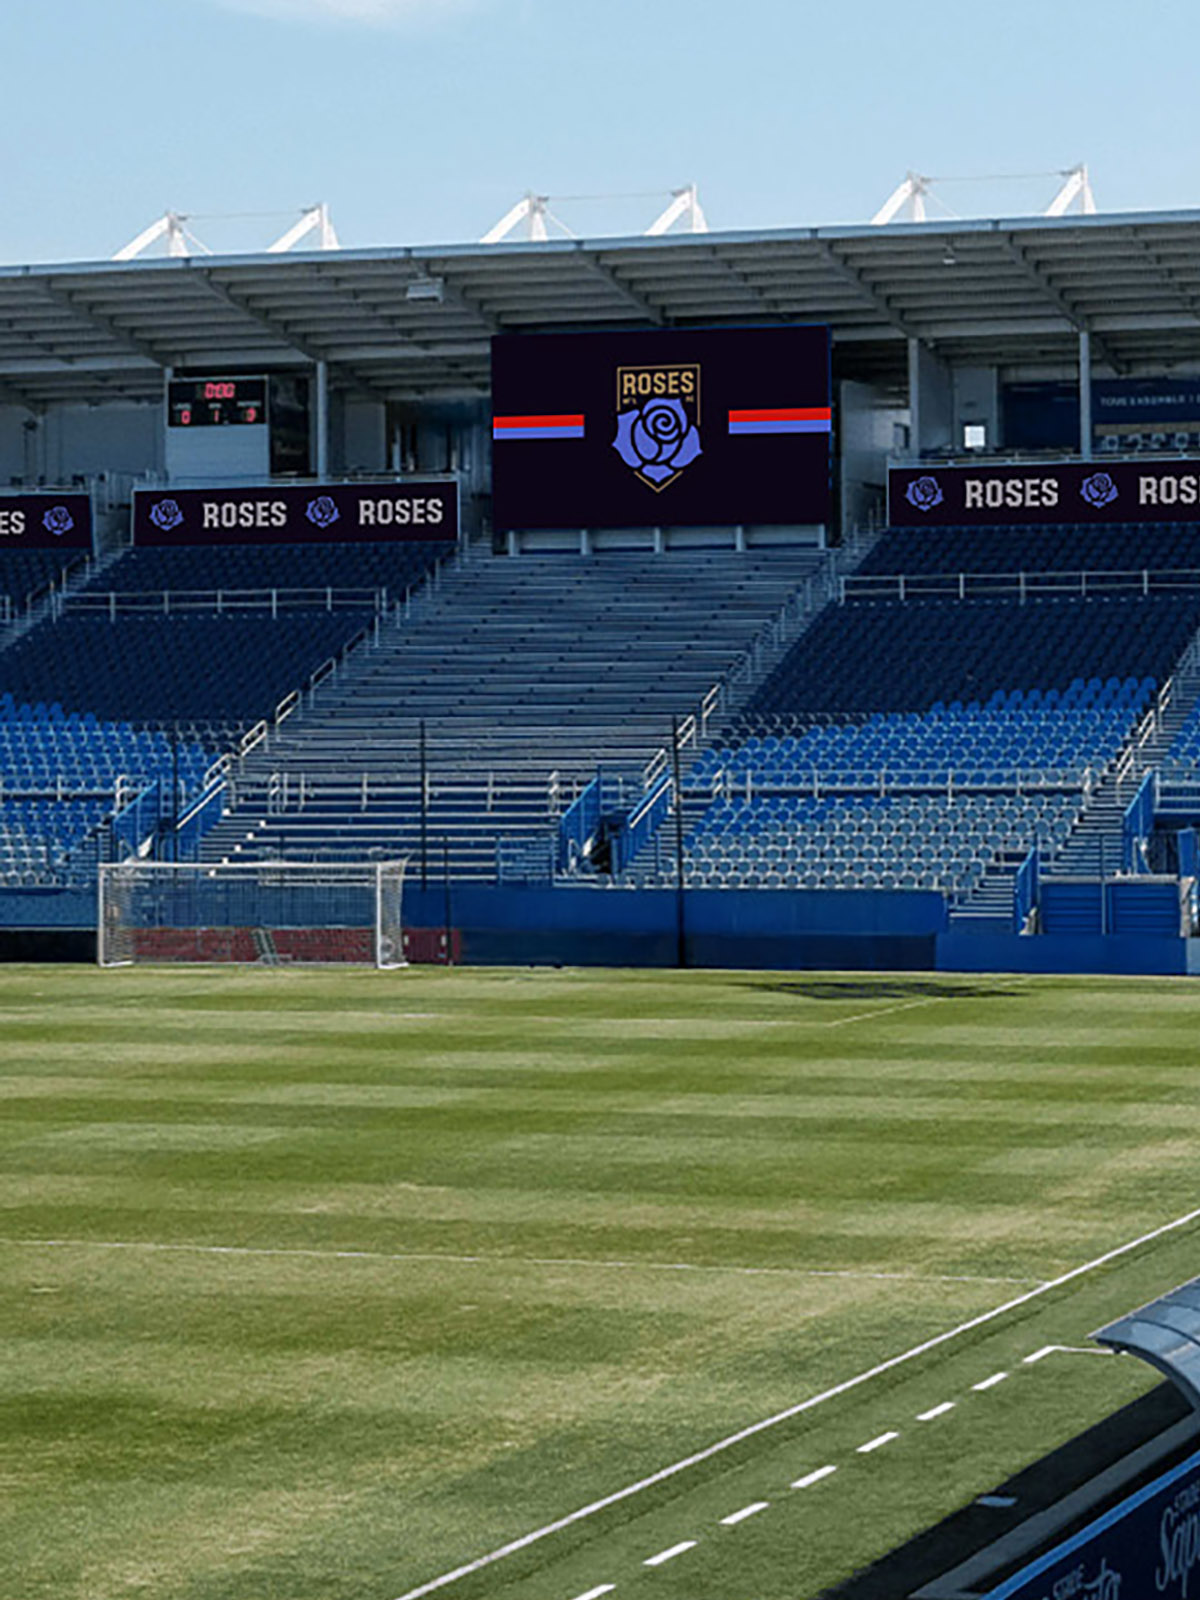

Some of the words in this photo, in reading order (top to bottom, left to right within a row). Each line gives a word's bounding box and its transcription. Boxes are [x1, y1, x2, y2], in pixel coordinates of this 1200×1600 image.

[623, 371, 694, 395] ROSES
[965, 478, 1059, 508] ROSES
[203, 501, 287, 528] ROSES
[359, 498, 443, 525] ROSES
